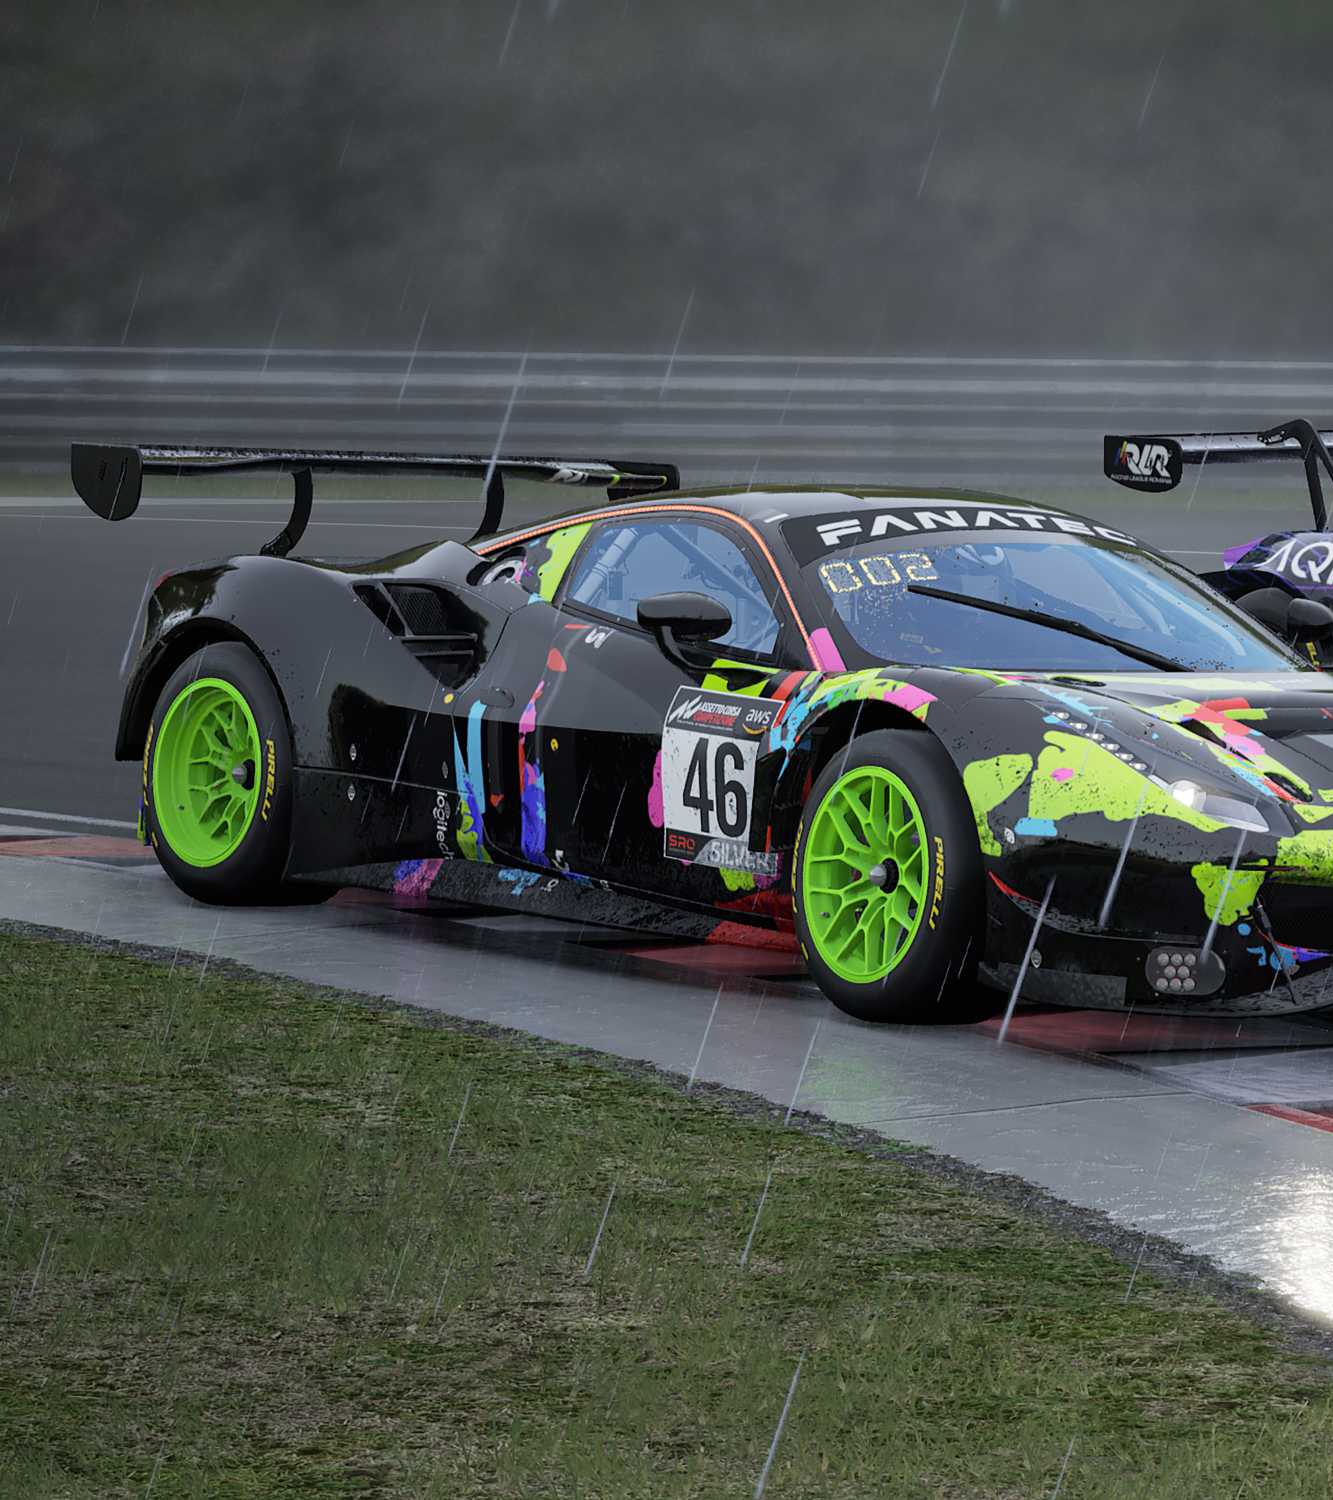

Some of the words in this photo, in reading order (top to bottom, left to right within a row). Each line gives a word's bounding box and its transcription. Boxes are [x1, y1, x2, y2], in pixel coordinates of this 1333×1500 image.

[816, 509, 1137, 546] FANATEC
[820, 553, 939, 593] 002
[746, 708, 772, 725] aws
[262, 739, 276, 822] PIRELLI
[682, 737, 748, 838] 46
[668, 834, 696, 850] SRO
[929, 836, 945, 931] PIRELLI
